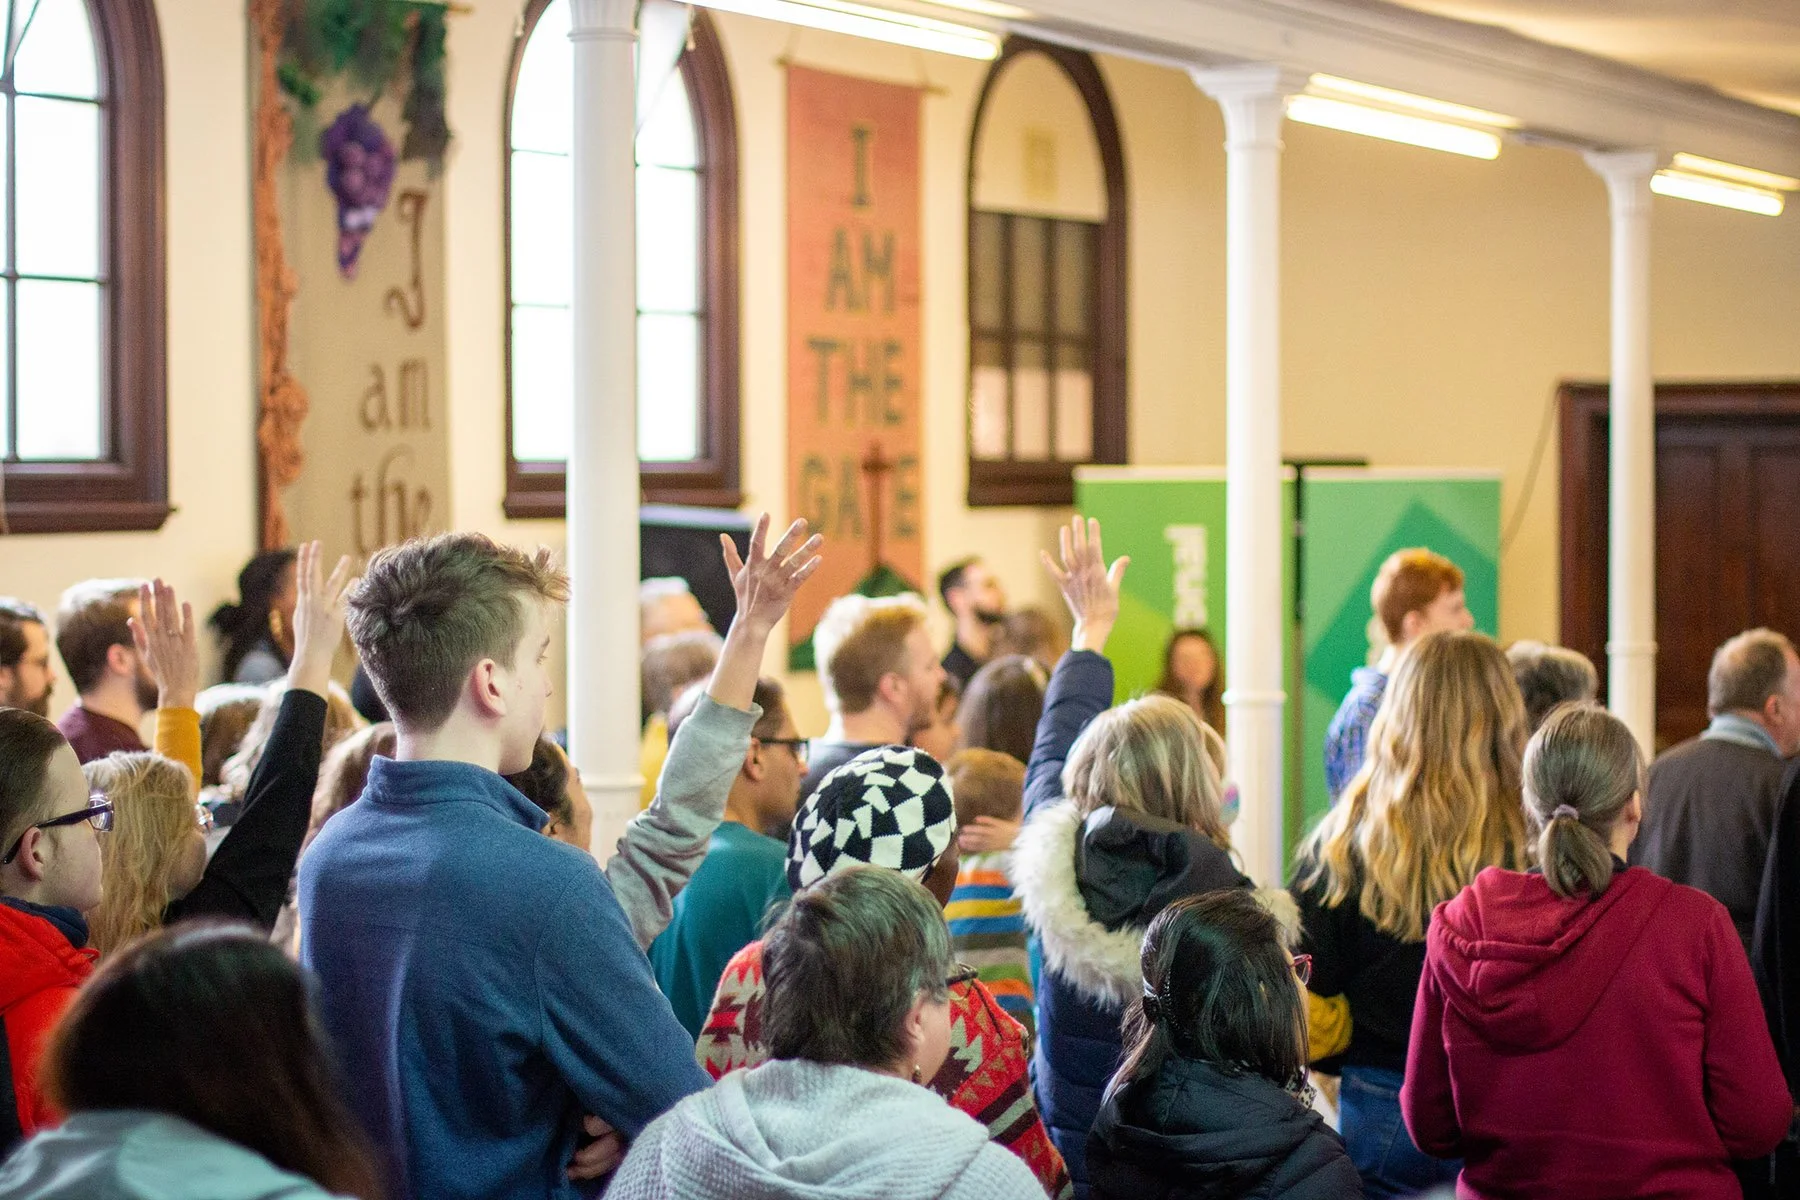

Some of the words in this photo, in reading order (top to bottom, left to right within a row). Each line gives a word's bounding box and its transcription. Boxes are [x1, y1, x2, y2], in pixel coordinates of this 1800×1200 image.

[852, 124, 873, 208] I
[826, 227, 896, 314] AM
[358, 357, 432, 433] am
[806, 335, 906, 426] THE
[349, 444, 433, 557] the
[797, 446, 919, 544] GATE
